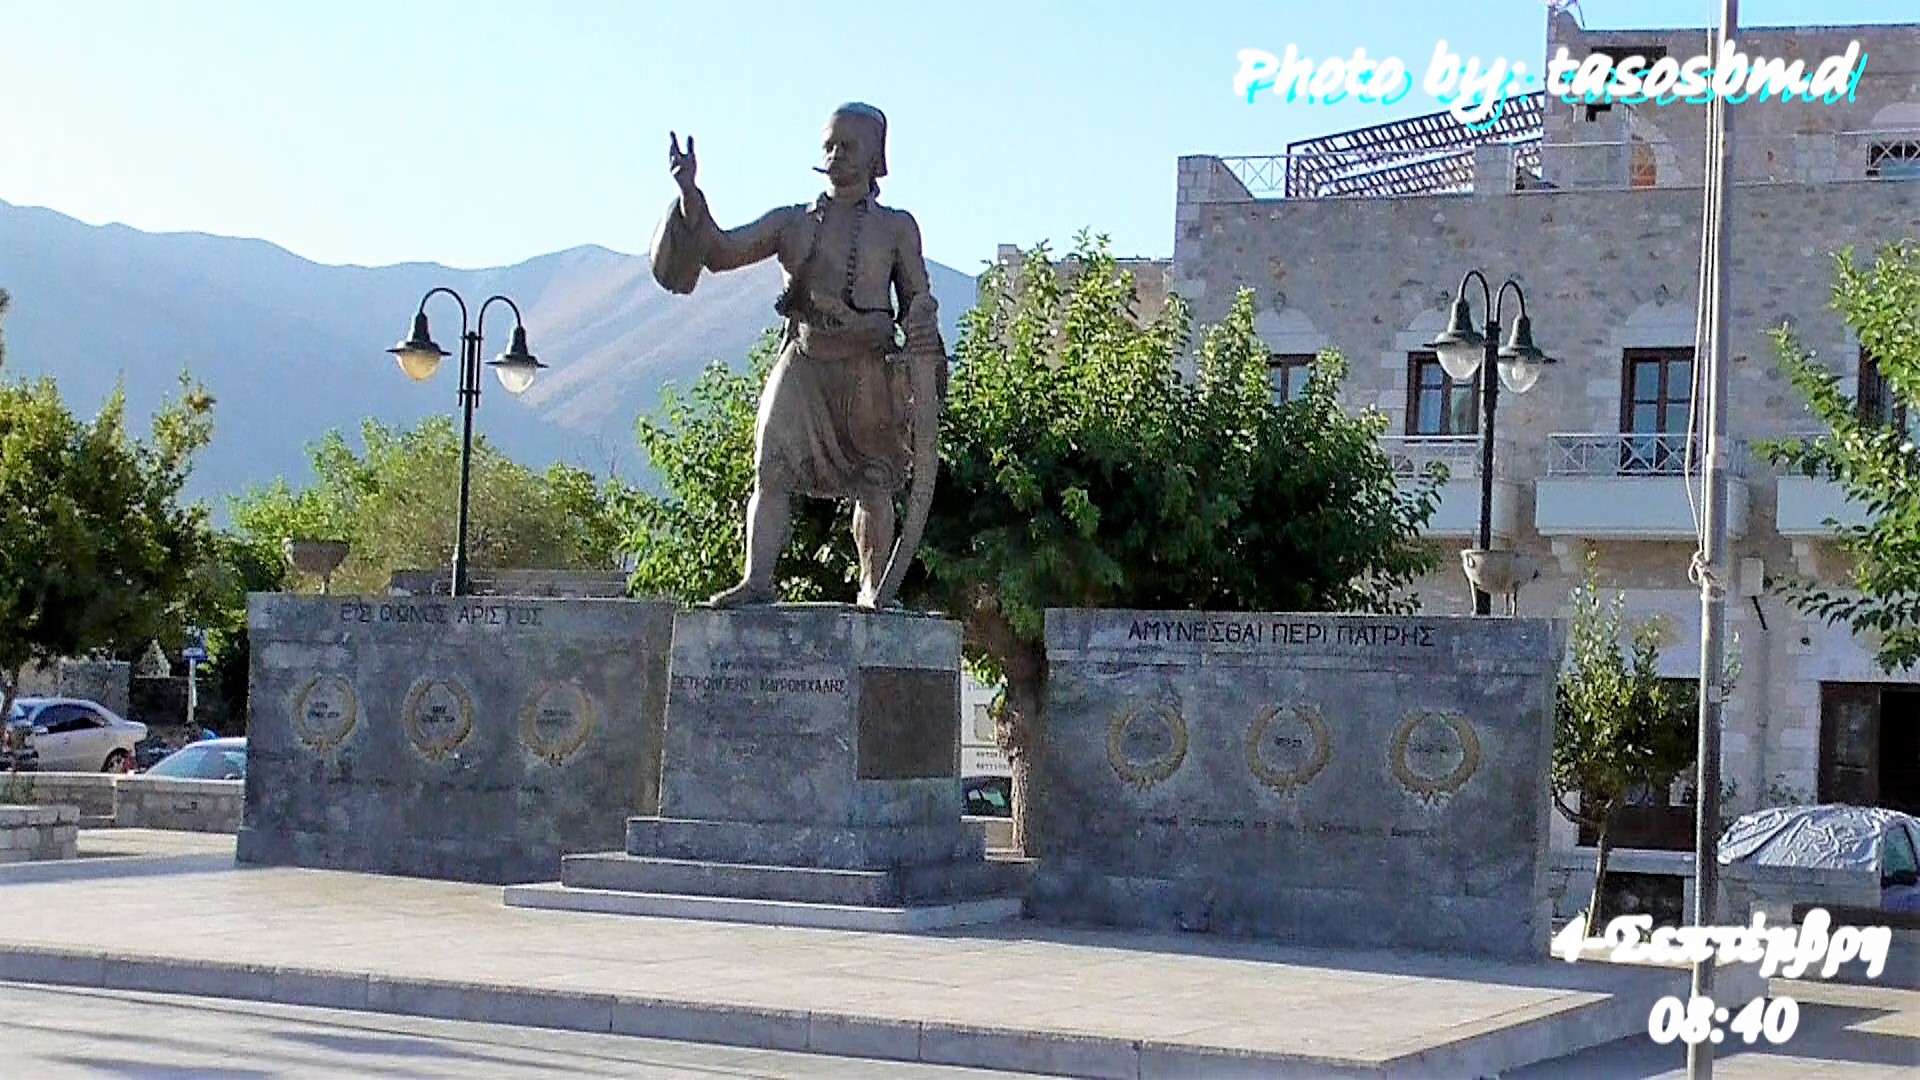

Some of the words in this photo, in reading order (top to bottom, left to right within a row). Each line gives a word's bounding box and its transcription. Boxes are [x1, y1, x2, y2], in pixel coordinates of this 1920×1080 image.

[1128, 620, 1262, 643] ΑΜΥΝΕΣΘΑΙ
[1272, 623, 1327, 644] ΠΕΡΙ
[1337, 625, 1435, 647] ΠΑΤΡΗΣ
